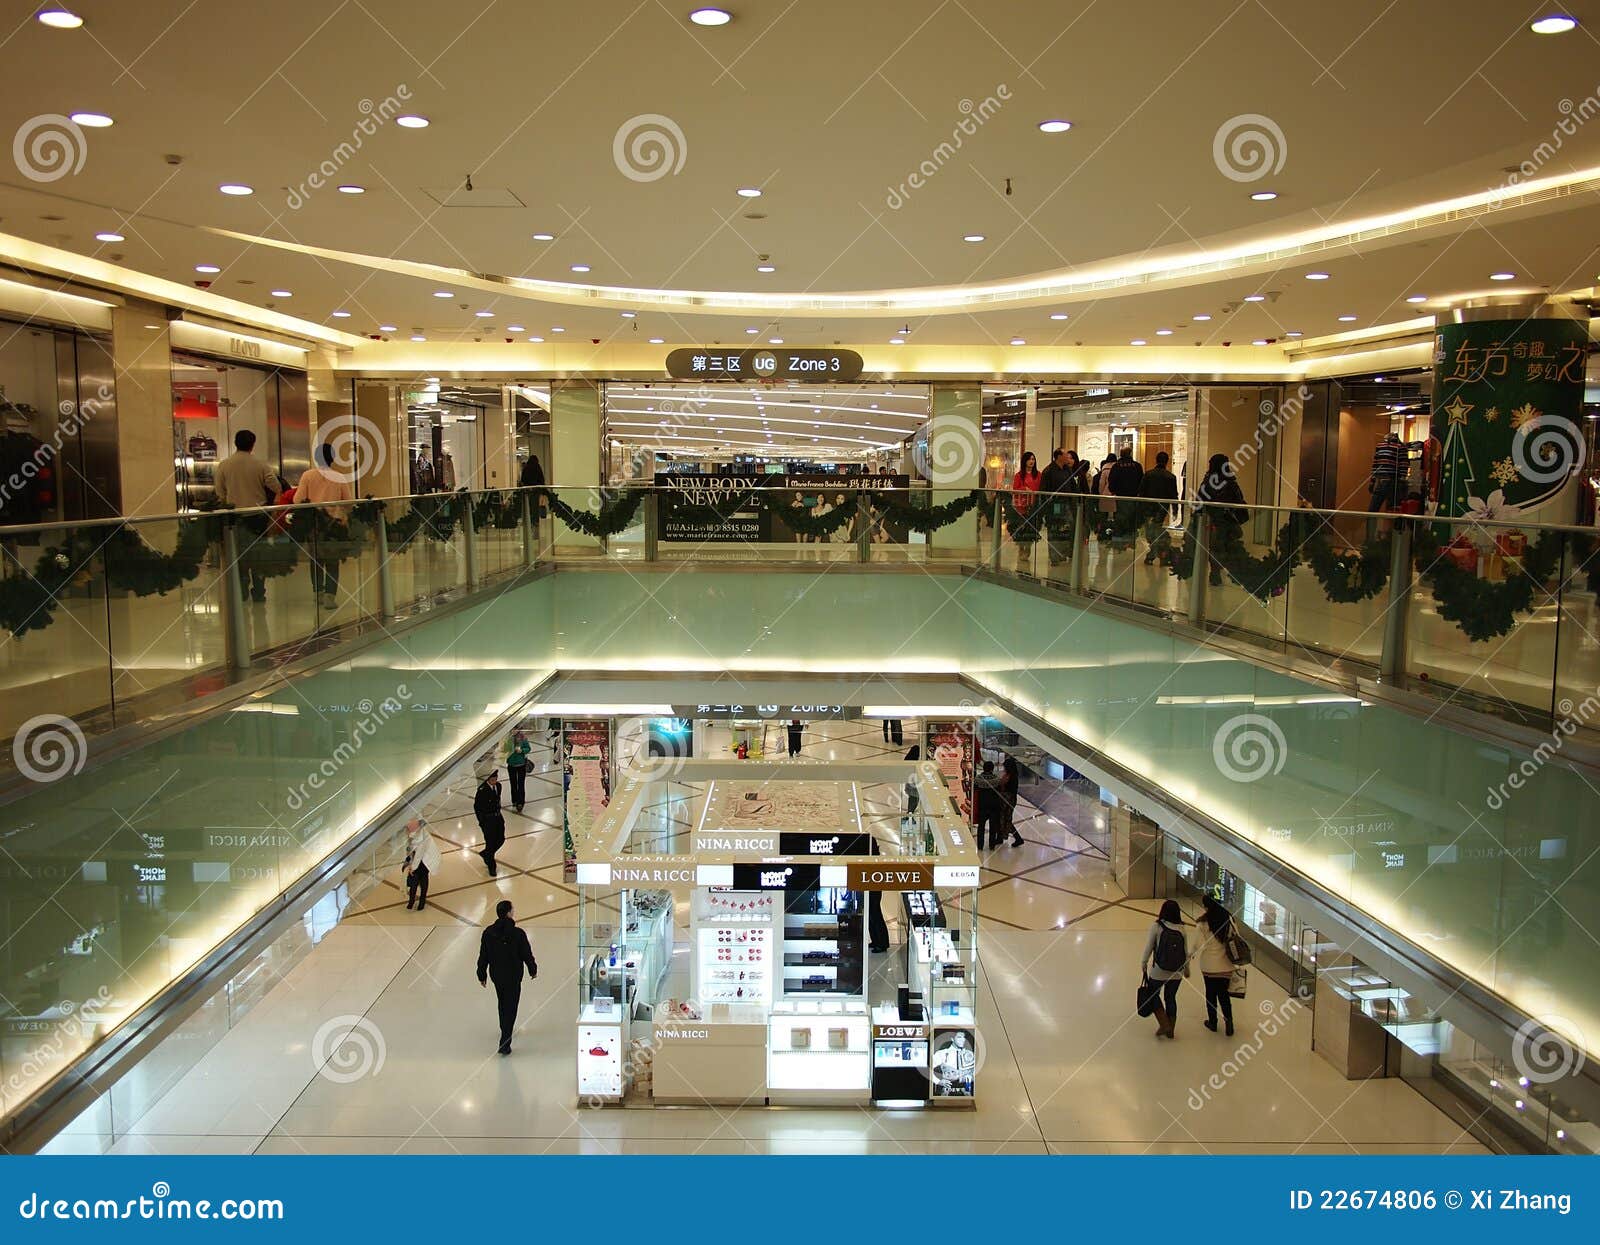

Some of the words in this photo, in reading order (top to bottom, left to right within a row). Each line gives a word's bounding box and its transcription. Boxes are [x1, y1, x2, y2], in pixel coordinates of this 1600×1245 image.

[692, 355, 741, 372] 第三区
[755, 357, 775, 371] UG
[788, 356, 827, 372] Zone
[831, 357, 840, 371] 3
[1443, 340, 1509, 383] 东方
[666, 477, 706, 492] NEW
[709, 477, 757, 493] BODY
[682, 491, 722, 506] NEW
[722, 524, 739, 532] 8515
[742, 524, 759, 532] 0280
[697, 838, 732, 850] NINA
[735, 838, 775, 850] RICCI
[612, 869, 650, 881] NINA
[653, 869, 695, 881] RICCI
[861, 871, 921, 883] LOEWE
[656, 1030, 680, 1038] NINA
[682, 1030, 708, 1038] RICCI
[879, 1027, 923, 1036] LOEWE
